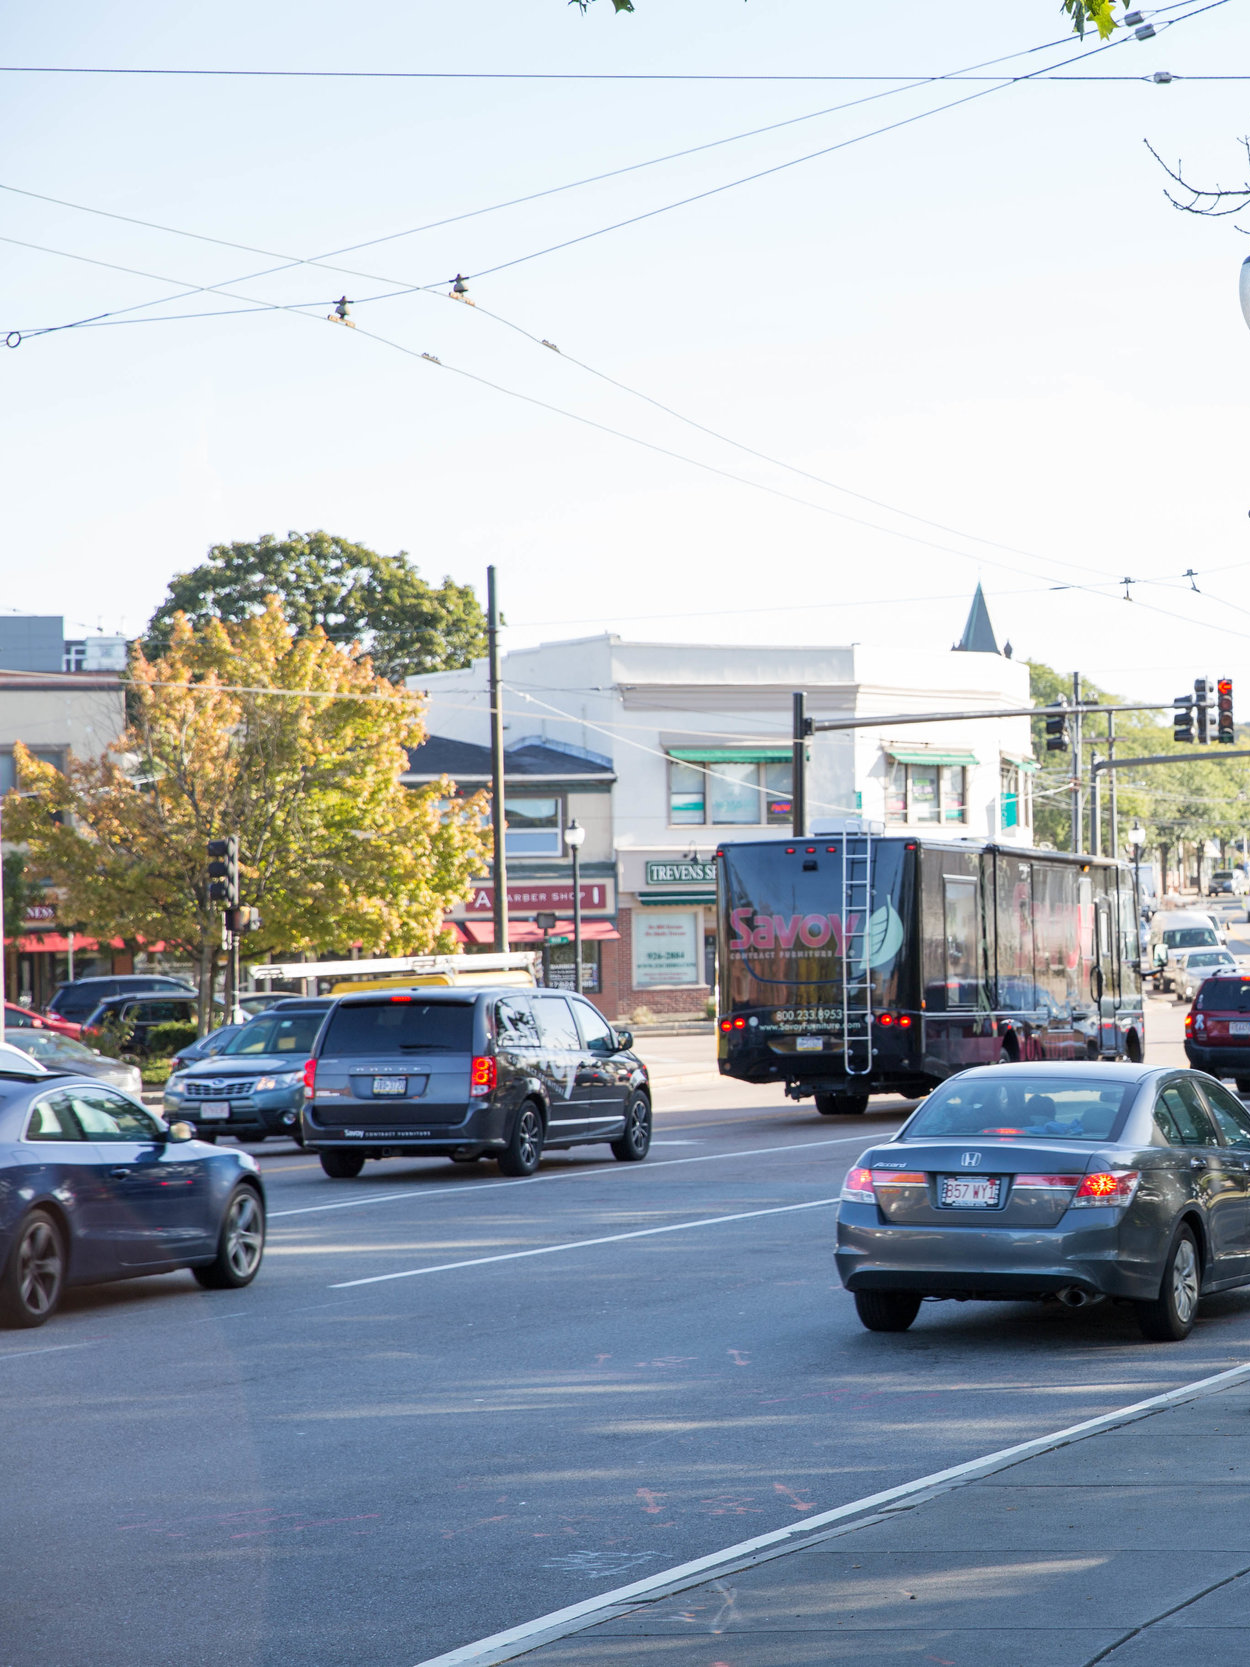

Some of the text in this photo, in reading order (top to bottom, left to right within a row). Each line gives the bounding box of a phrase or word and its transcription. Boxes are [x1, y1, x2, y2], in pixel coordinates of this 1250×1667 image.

[651, 864, 703, 881] TREVENS
[730, 907, 860, 957] Savoy
[730, 950, 832, 960] CONTRACT FURNITURE
[776, 1008, 843, 1021] 800.233.8953
[946, 1183, 969, 1199] 857
